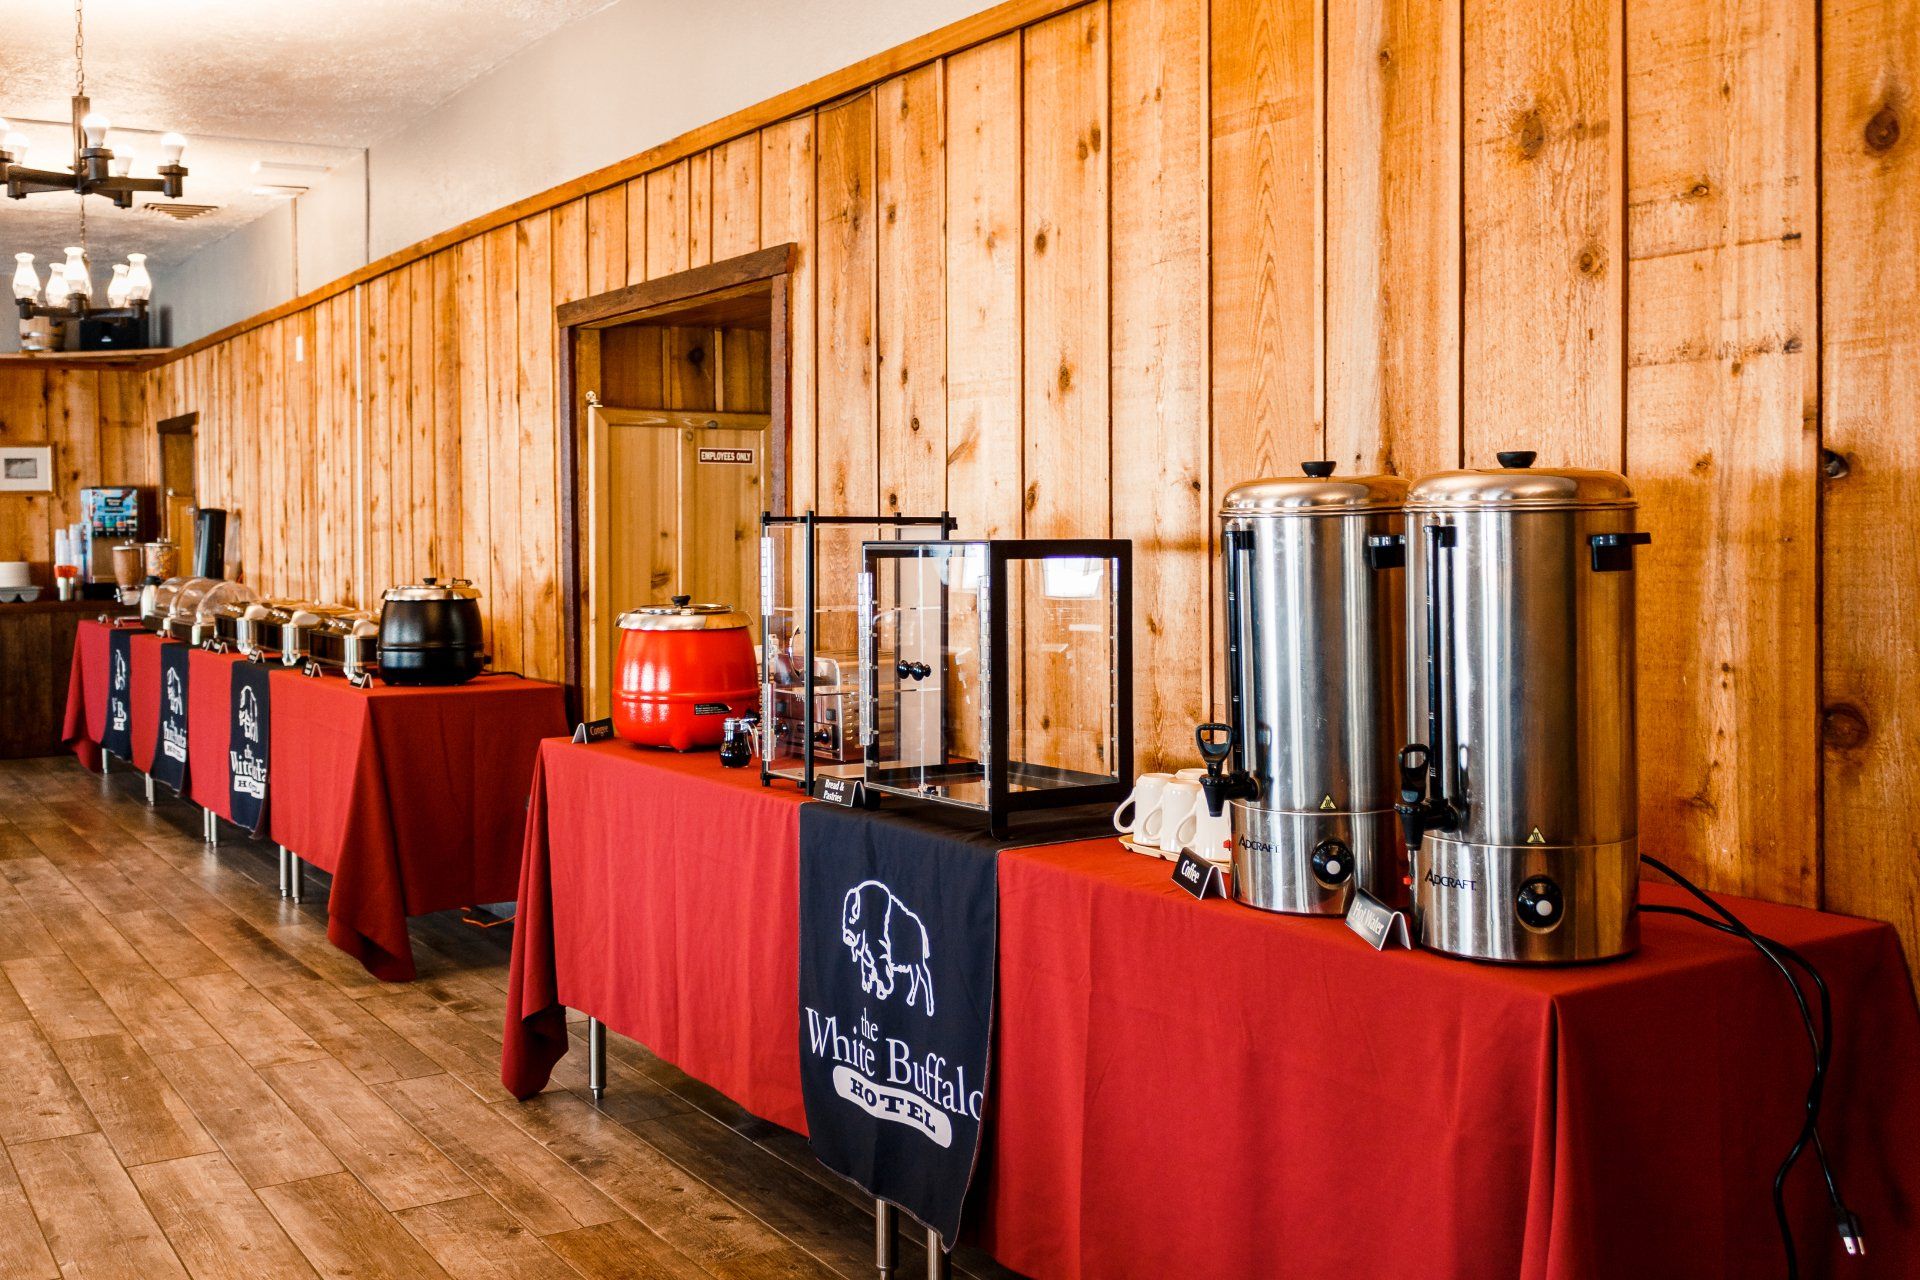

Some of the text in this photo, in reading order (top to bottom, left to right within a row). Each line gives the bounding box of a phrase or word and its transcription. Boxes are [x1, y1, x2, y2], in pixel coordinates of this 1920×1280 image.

[701, 451, 751, 461] EMPLOYEES ONLY
[823, 790, 842, 802] Pastries
[824, 779, 845, 791] Bread &
[1238, 834, 1279, 853] ADCRAFT
[1181, 860, 1200, 884] Coffee
[1424, 868, 1476, 891] ADCRAFT
[1352, 901, 1385, 935] Hot Water
[861, 1007, 878, 1042] the
[805, 1006, 875, 1077] White
[850, 1076, 936, 1134] HOTEL
